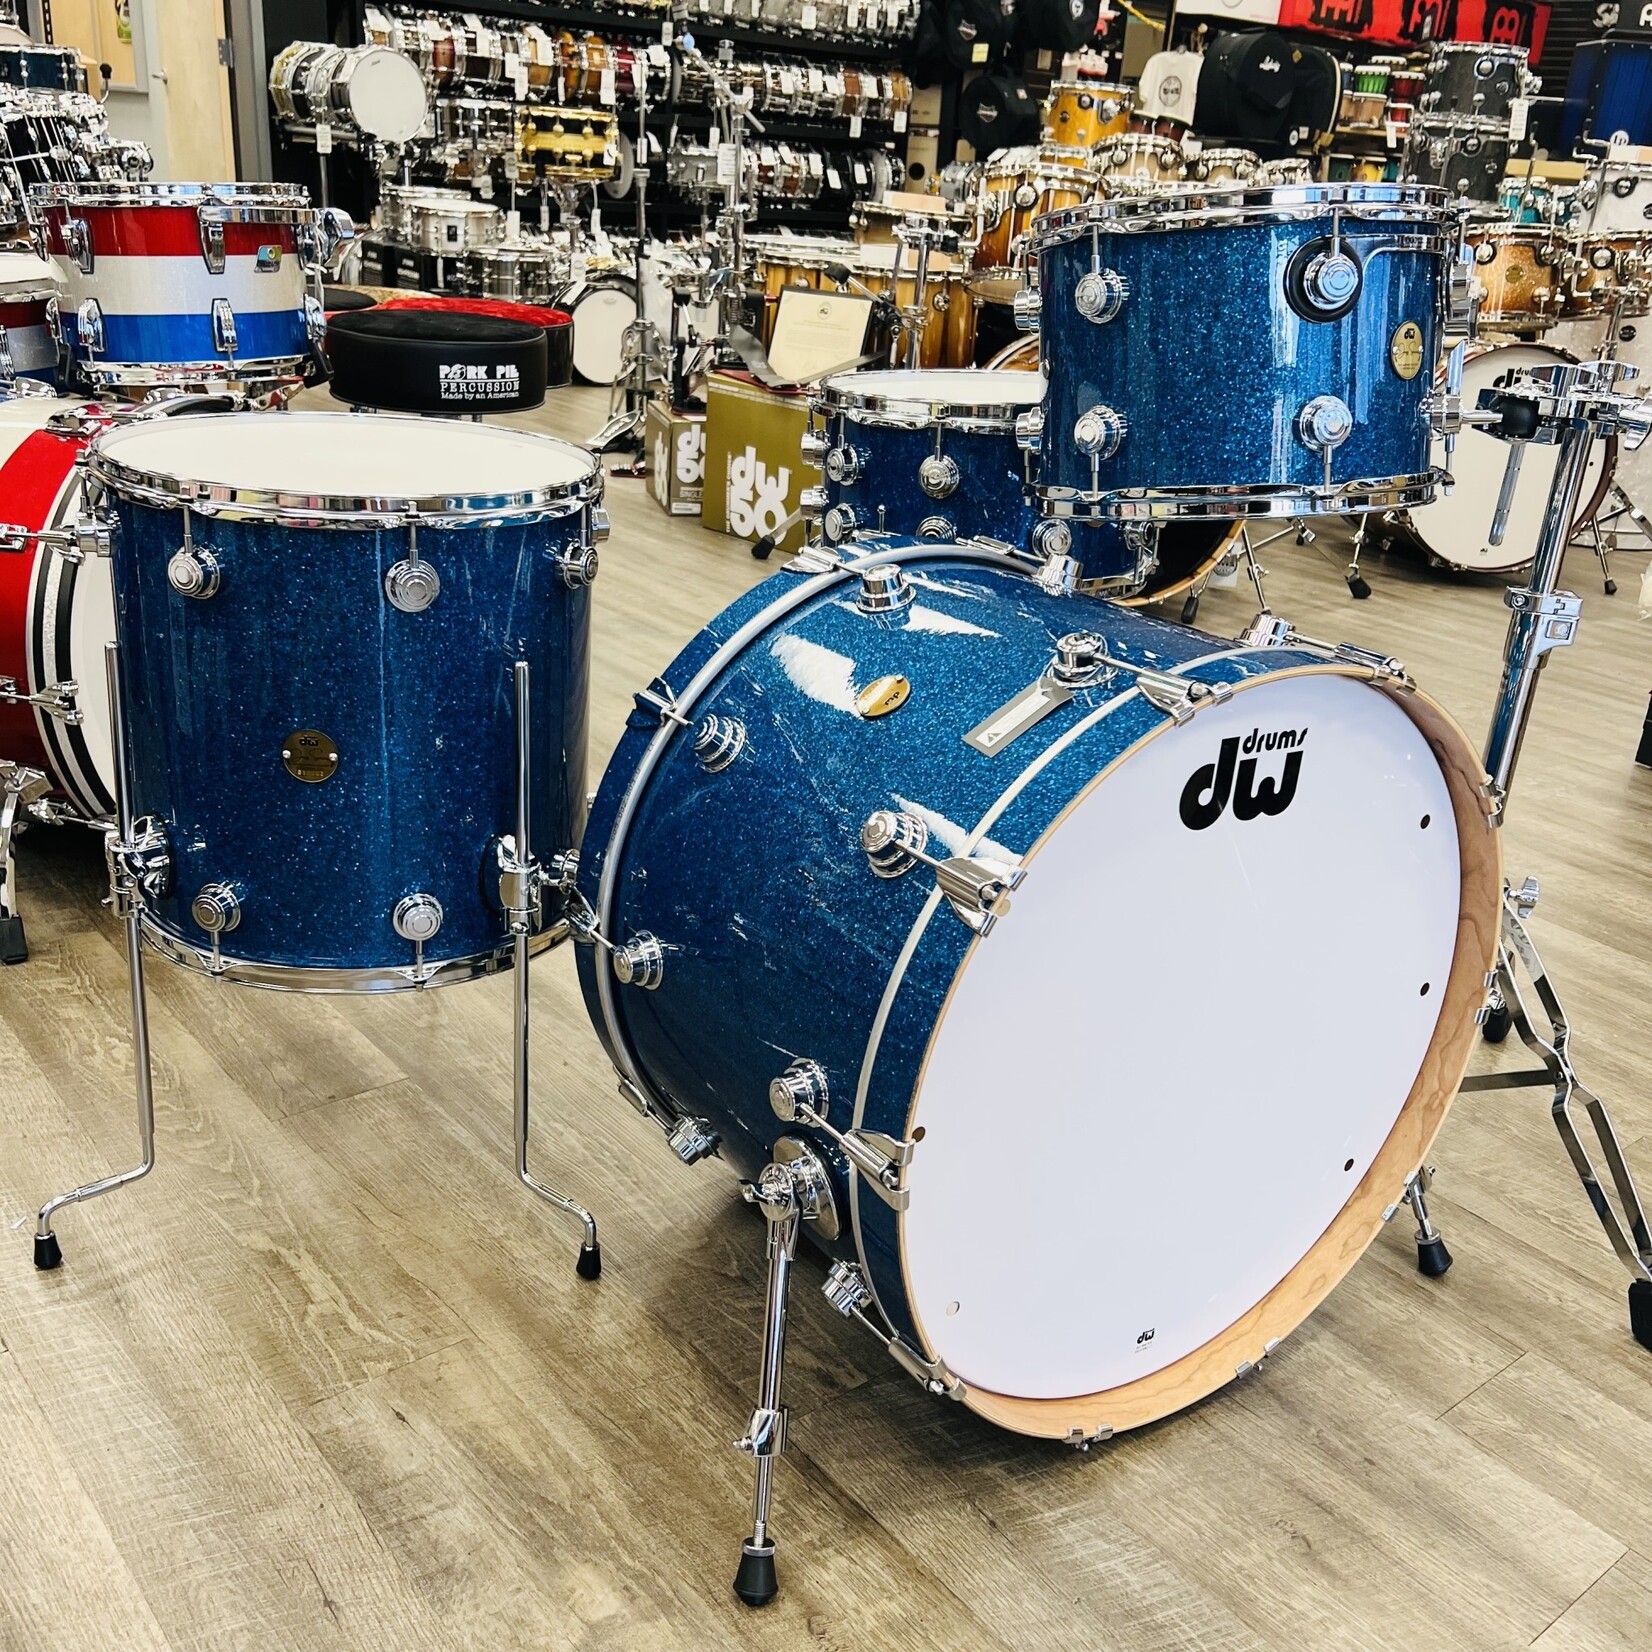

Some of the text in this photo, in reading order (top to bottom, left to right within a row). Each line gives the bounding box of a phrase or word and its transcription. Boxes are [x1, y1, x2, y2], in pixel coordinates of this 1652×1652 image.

[439, 364, 519, 380] PORK PIE
[440, 381, 520, 393] PERCUSSION
[441, 392, 460, 400] Made
[464, 392, 475, 401] by
[487, 391, 519, 399] American
[1242, 727, 1309, 755] drums
[1179, 736, 1304, 831] dw
[1136, 1331, 1155, 1344] dw
